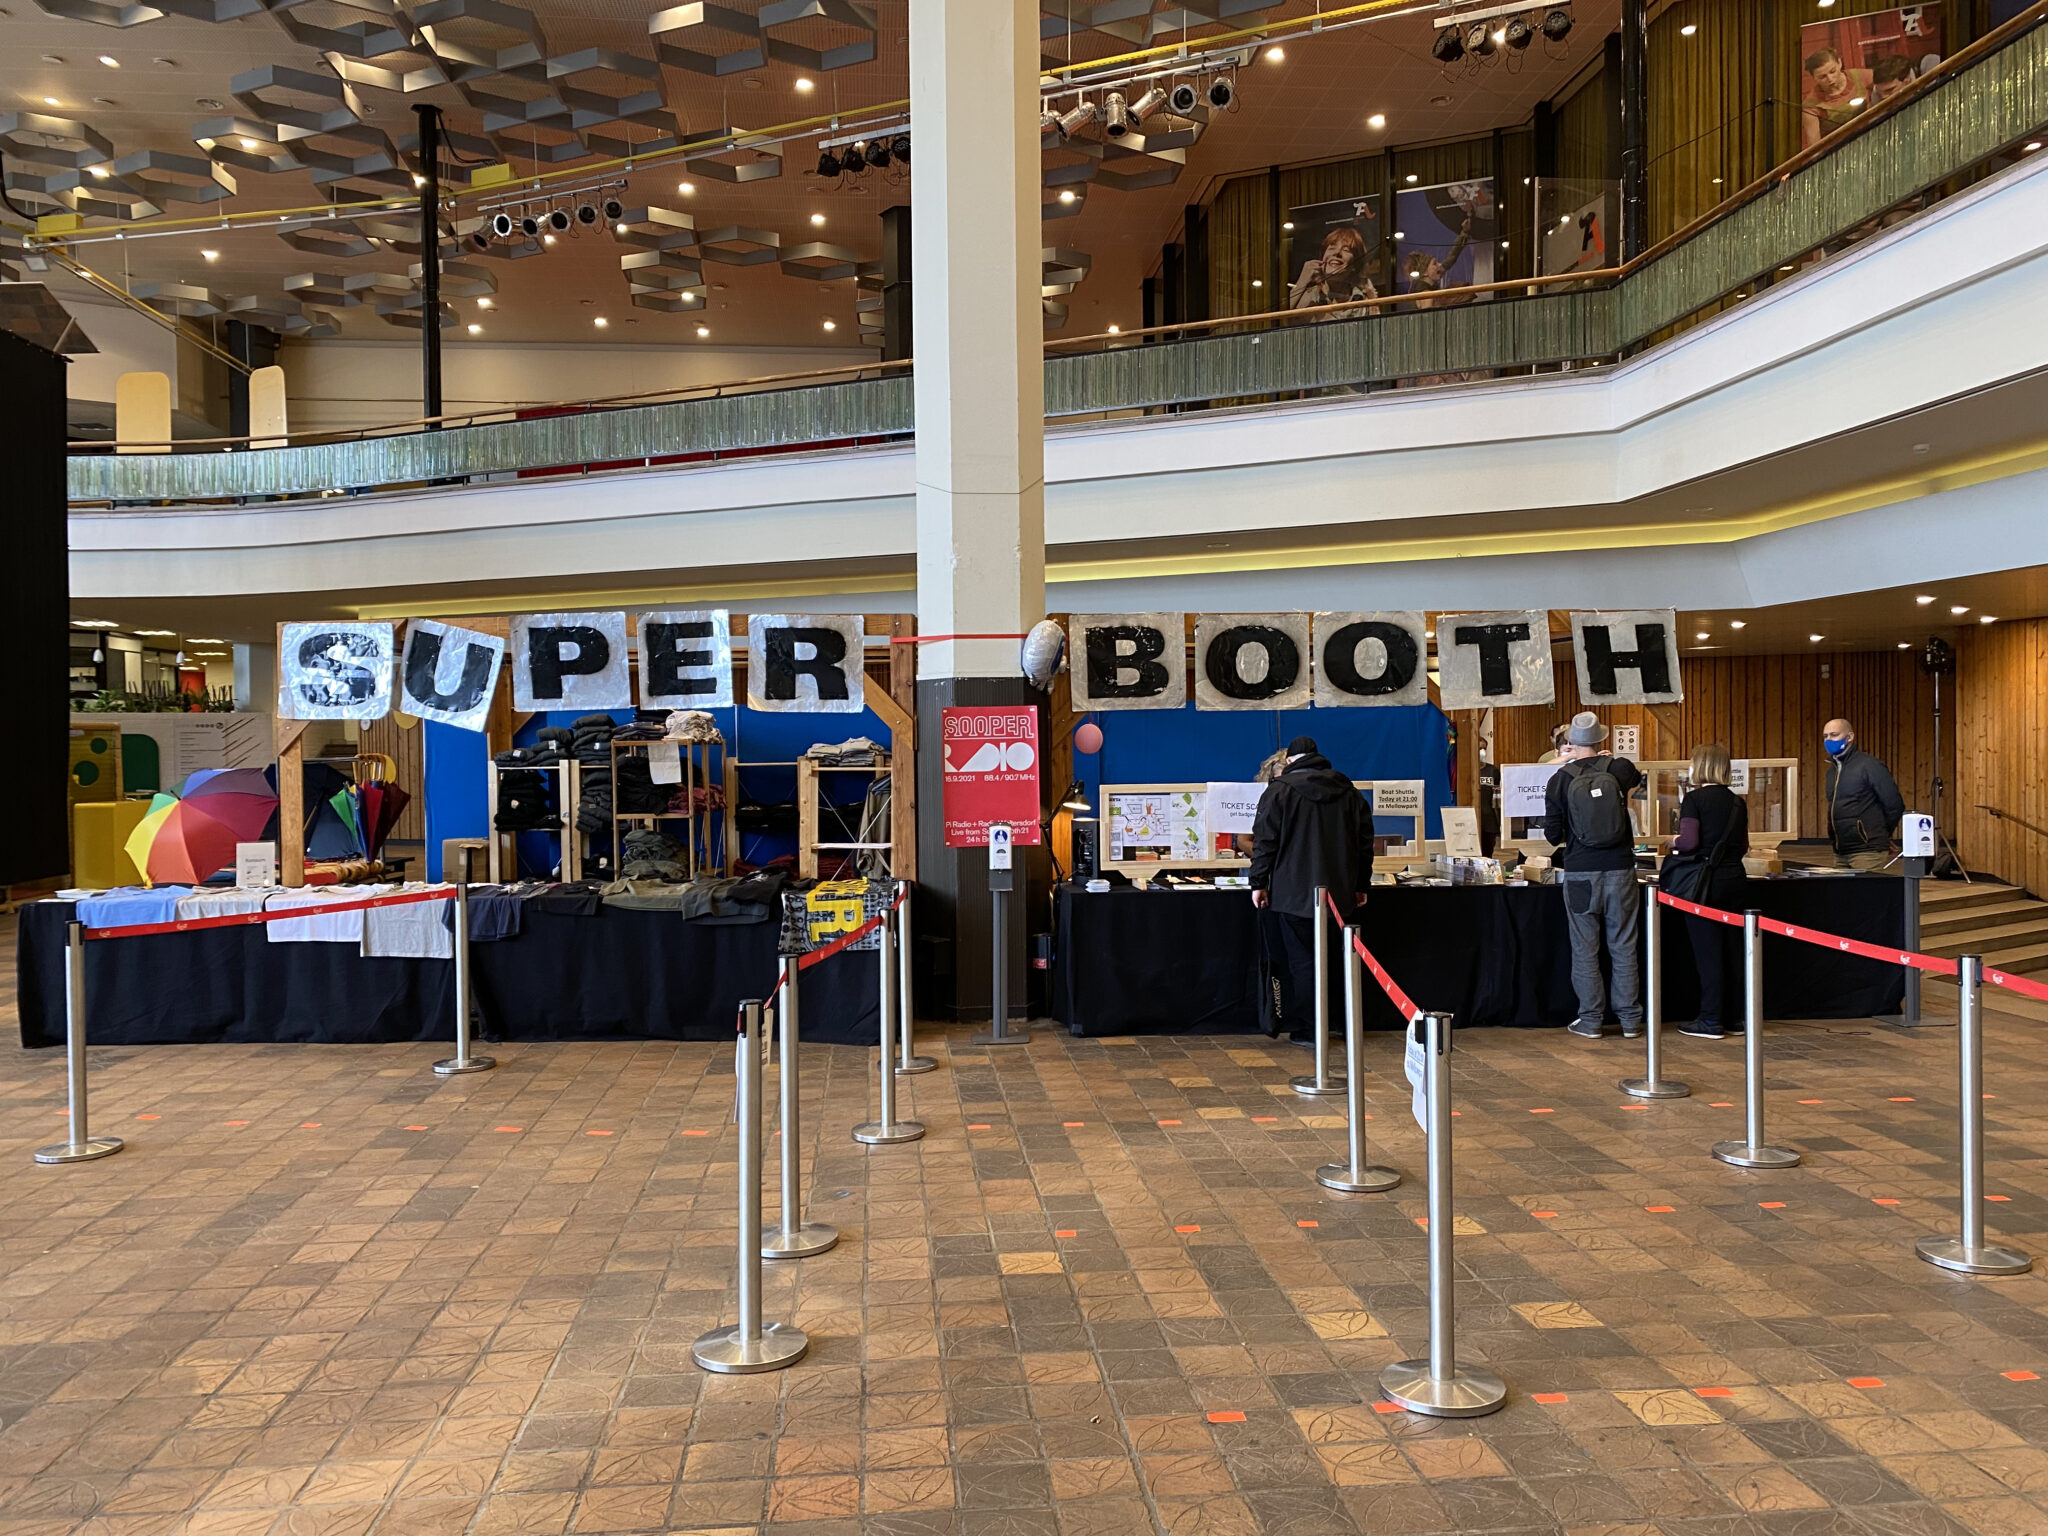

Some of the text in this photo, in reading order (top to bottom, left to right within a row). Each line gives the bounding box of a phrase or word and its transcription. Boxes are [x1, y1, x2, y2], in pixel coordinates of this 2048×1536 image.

[299, 620, 1673, 712] SUPER BOOTH
[944, 715, 1034, 740] SOOPER
[1517, 785, 1540, 793] TICKET
[1221, 801, 1245, 810] TICKET
[952, 820, 972, 828] Radio
